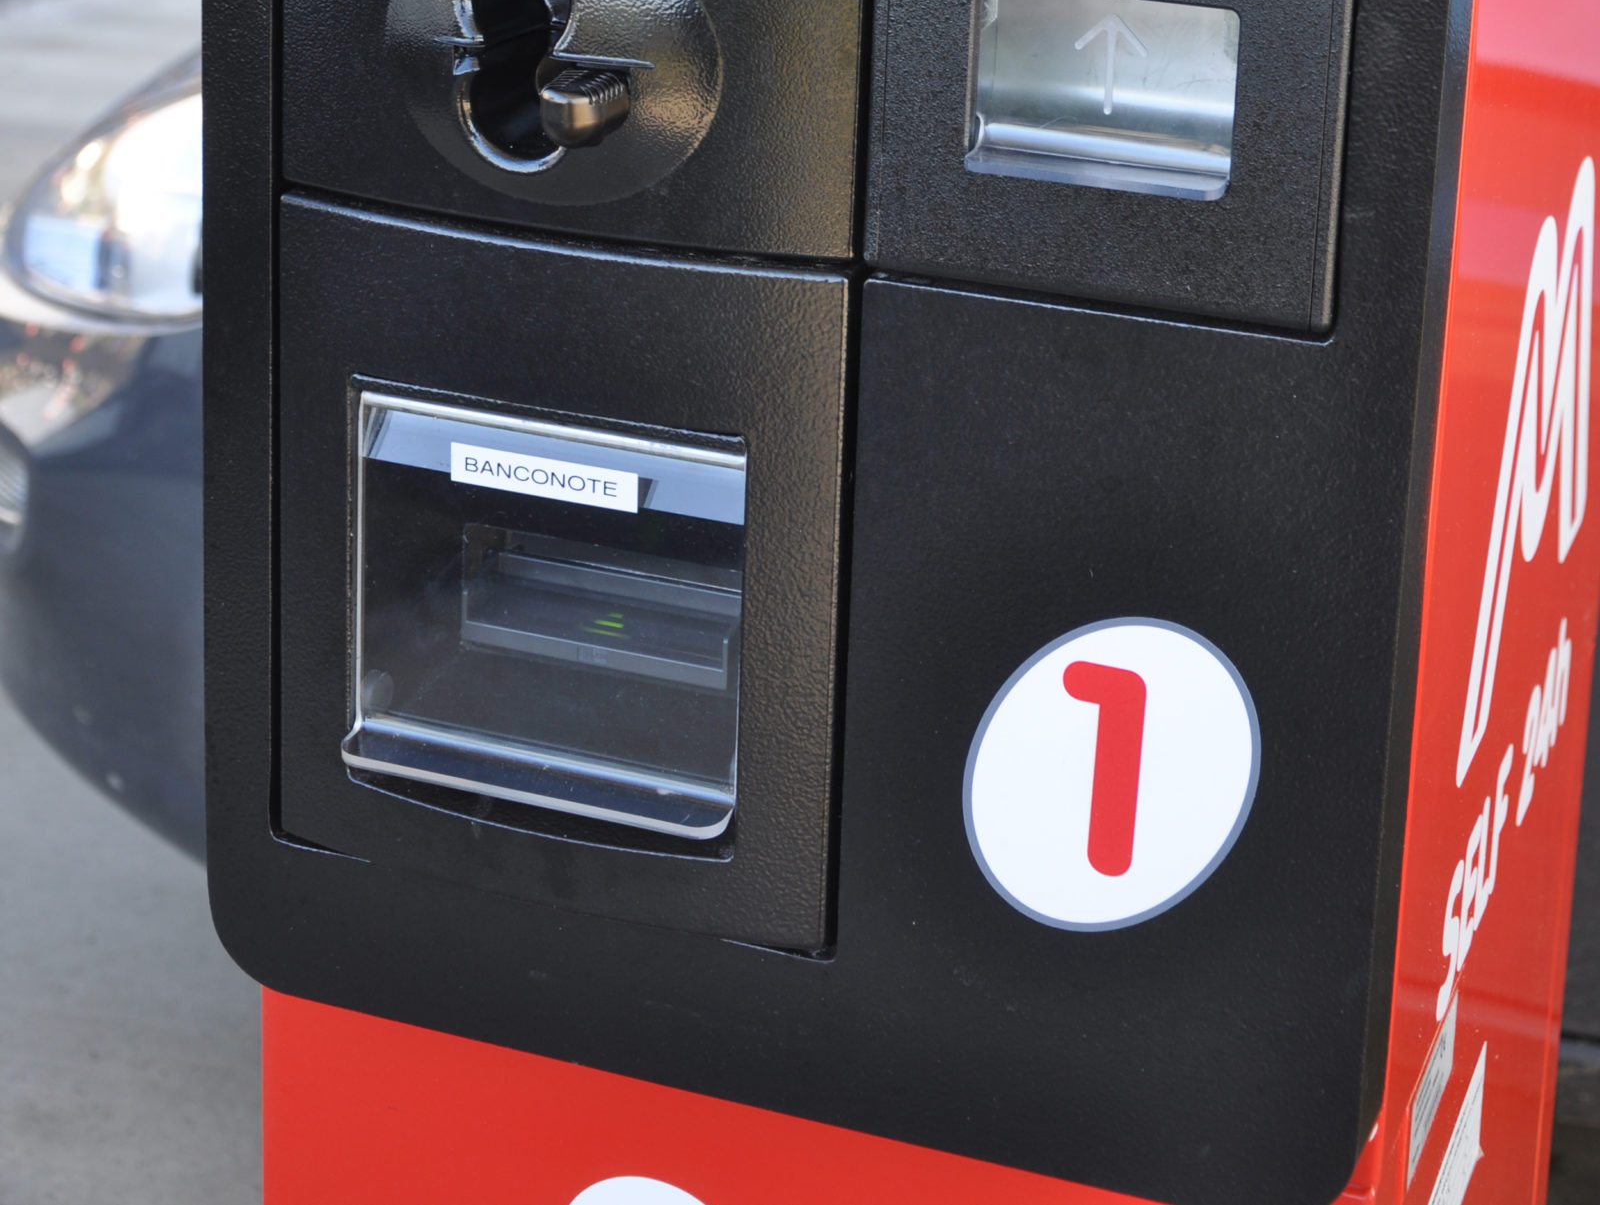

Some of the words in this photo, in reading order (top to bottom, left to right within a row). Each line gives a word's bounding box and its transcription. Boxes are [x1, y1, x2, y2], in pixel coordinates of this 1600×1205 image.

[465, 457, 618, 498] BANCONOTE
[1062, 660, 1147, 877] 1
[1436, 744, 1514, 1022] SELF
